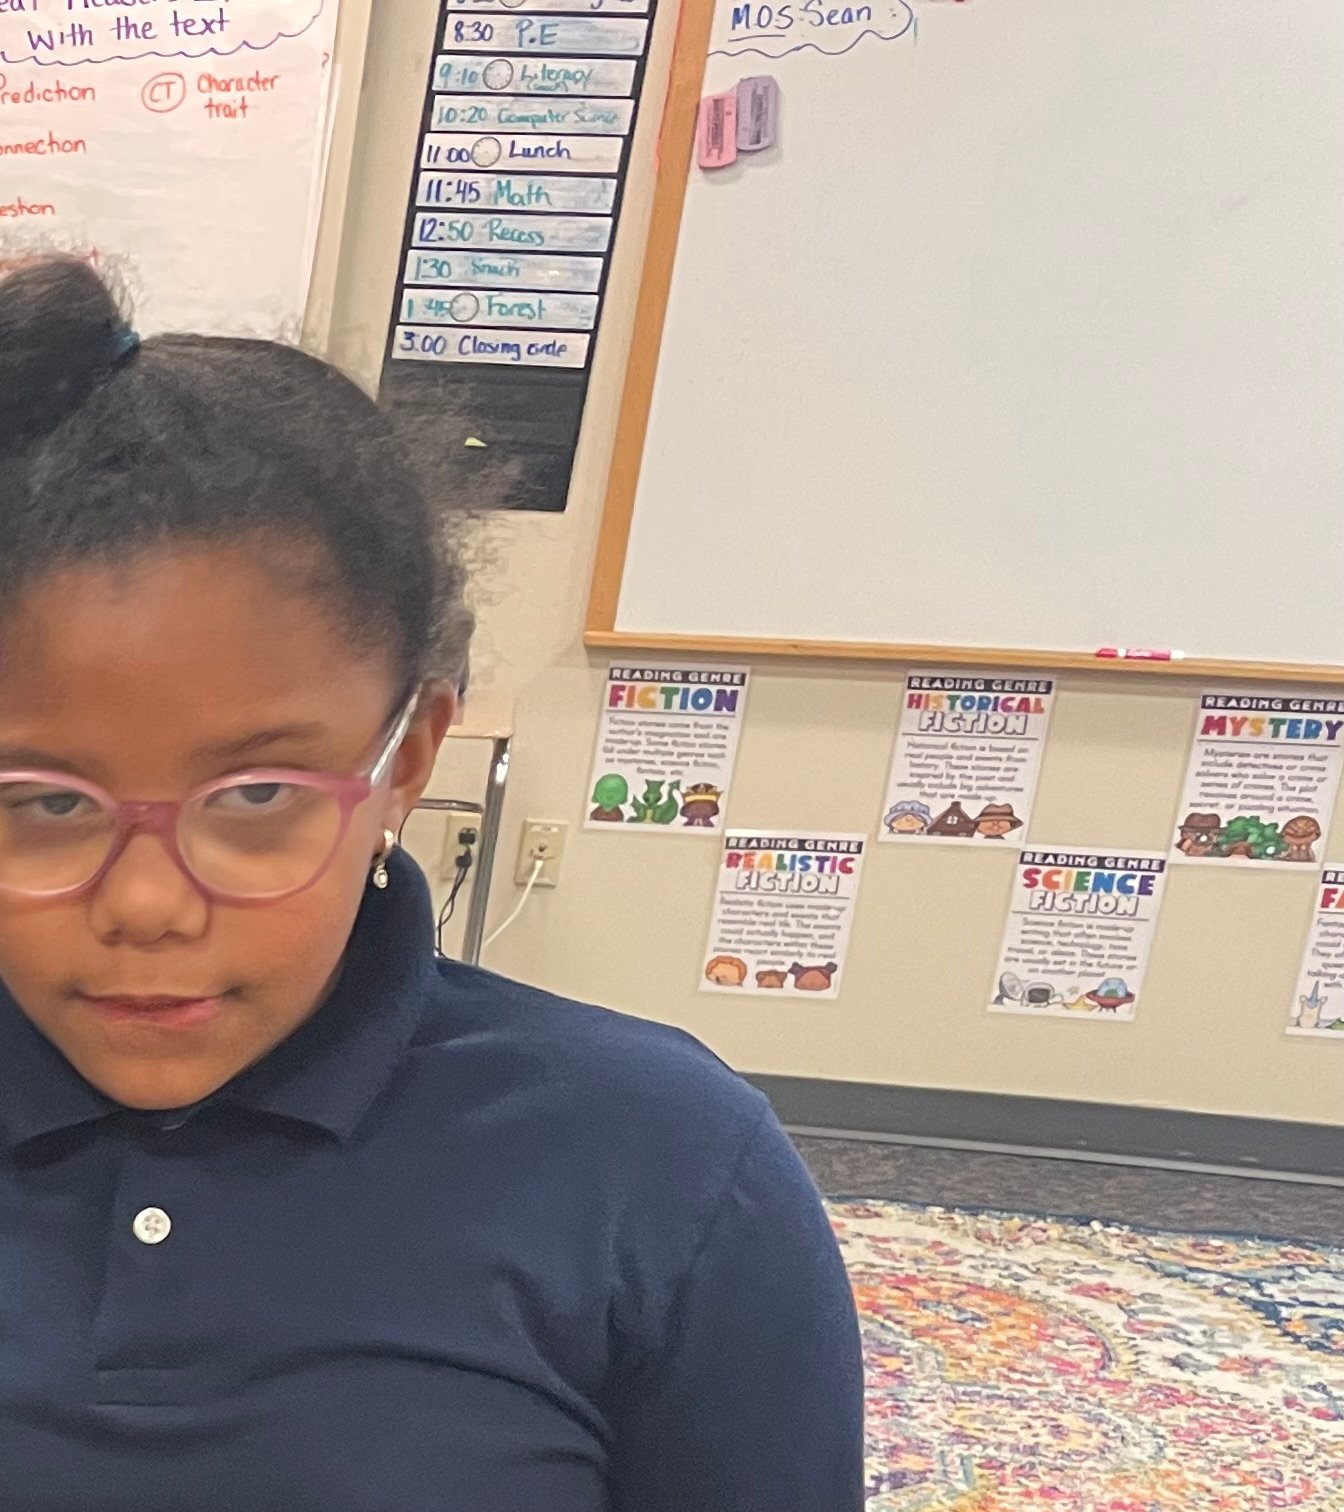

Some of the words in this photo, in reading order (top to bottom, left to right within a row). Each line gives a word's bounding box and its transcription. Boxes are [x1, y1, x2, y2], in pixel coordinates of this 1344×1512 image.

[111, 16, 157, 40] the
[169, 7, 230, 36] text
[197, 70, 281, 94] Character
[205, 99, 249, 119] trait
[437, 106, 488, 125] 10:20
[497, 108, 571, 128] Computer
[509, 140, 572, 160] Lunch
[425, 179, 481, 204] 11:45
[493, 179, 553, 206] Math
[419, 217, 474, 242] 12:50
[484, 218, 545, 246] Recess
[487, 295, 546, 320] Forest
[458, 334, 522, 361] Closing
[612, 668, 683, 682] READING
[688, 670, 742, 684] GENRE
[910, 678, 985, 690] READING
[992, 679, 1048, 693] GENRE
[609, 684, 739, 712] FICTION
[907, 693, 1045, 714] HISTORICAL
[1204, 696, 1283, 710] READING
[1289, 699, 1344, 713] GENRE
[918, 711, 1028, 735] FICTION
[1201, 715, 1344, 741] MYSTERY
[727, 837, 799, 850] READING
[804, 839, 860, 853] GENRE
[725, 852, 856, 875] REALISTIC
[1022, 853, 1098, 867] READING
[1104, 856, 1161, 871] GENRE
[735, 870, 840, 895] FICTION
[1022, 867, 1156, 896] SCIENCE
[1029, 890, 1140, 917] FICTION
